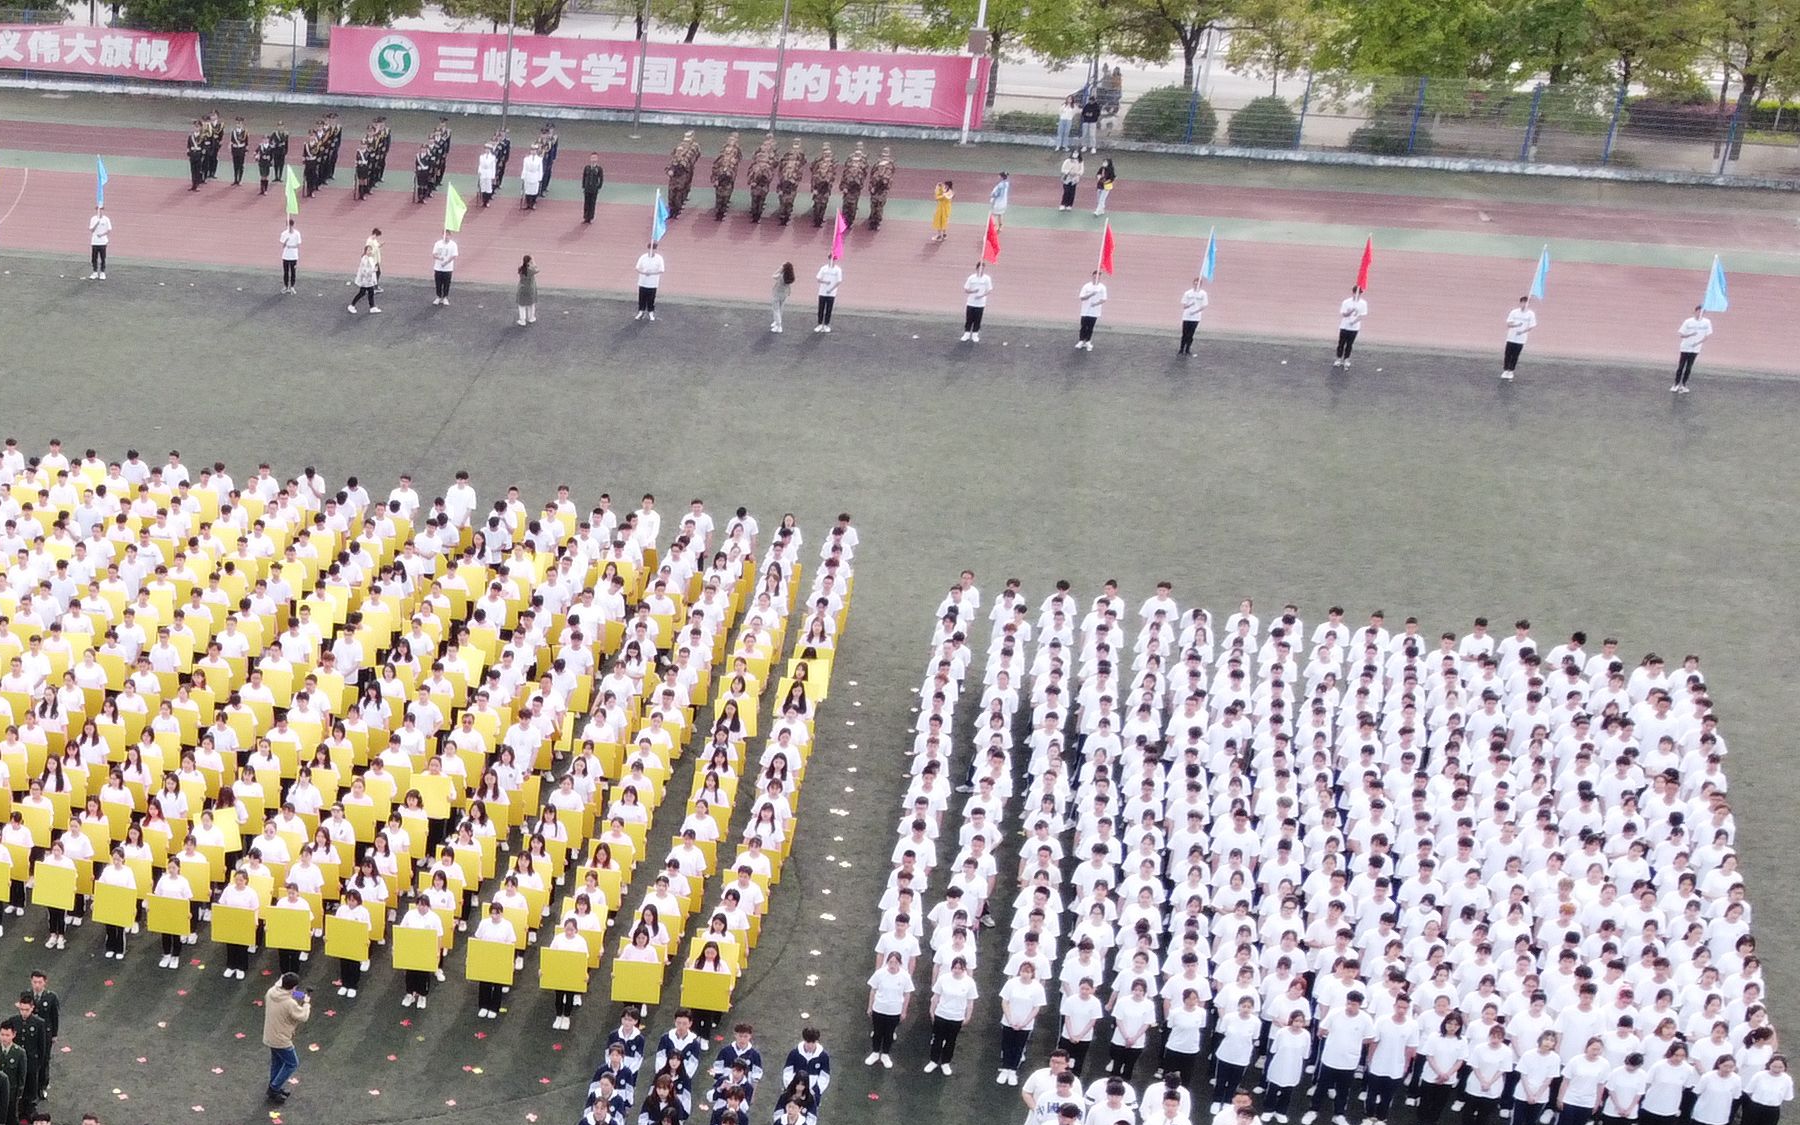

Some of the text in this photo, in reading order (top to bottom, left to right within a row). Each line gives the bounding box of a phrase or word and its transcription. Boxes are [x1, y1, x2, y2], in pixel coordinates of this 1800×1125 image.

[433, 45, 937, 110] 三峡大学国旗下的讲话
